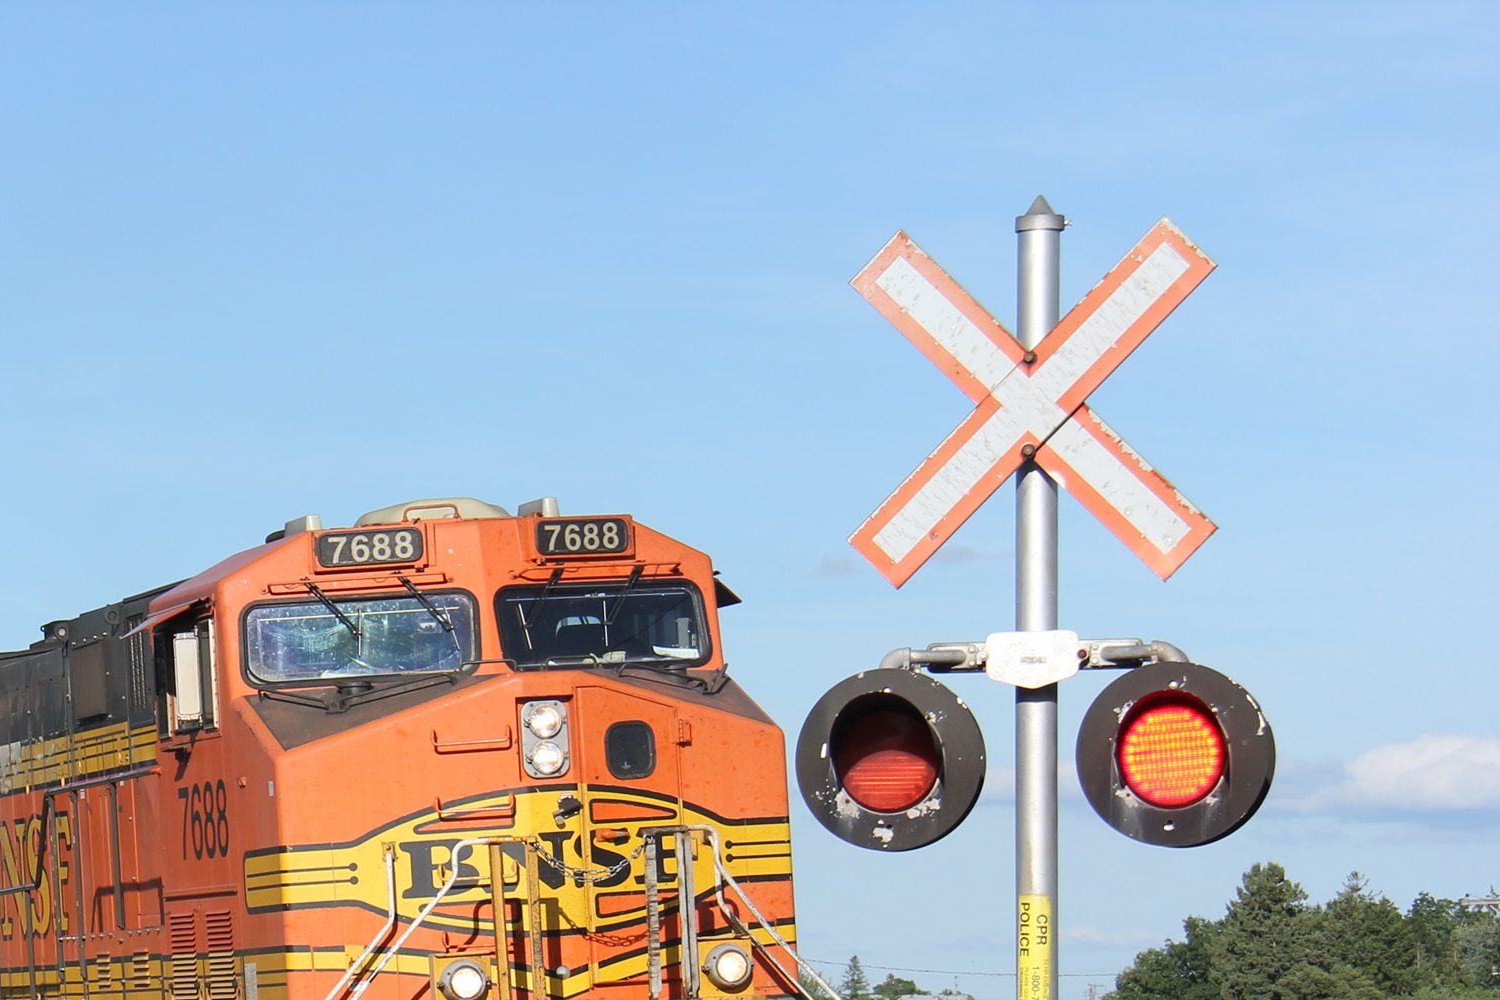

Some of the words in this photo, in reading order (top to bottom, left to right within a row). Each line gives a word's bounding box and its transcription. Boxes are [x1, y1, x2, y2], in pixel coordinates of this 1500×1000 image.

[327, 530, 414, 564] 7688
[544, 521, 620, 551] 7688
[178, 779, 229, 860] 7688
[399, 826, 687, 899] BNSF
[1019, 902, 1030, 957] POLICE
[1036, 914, 1048, 945] CPR
